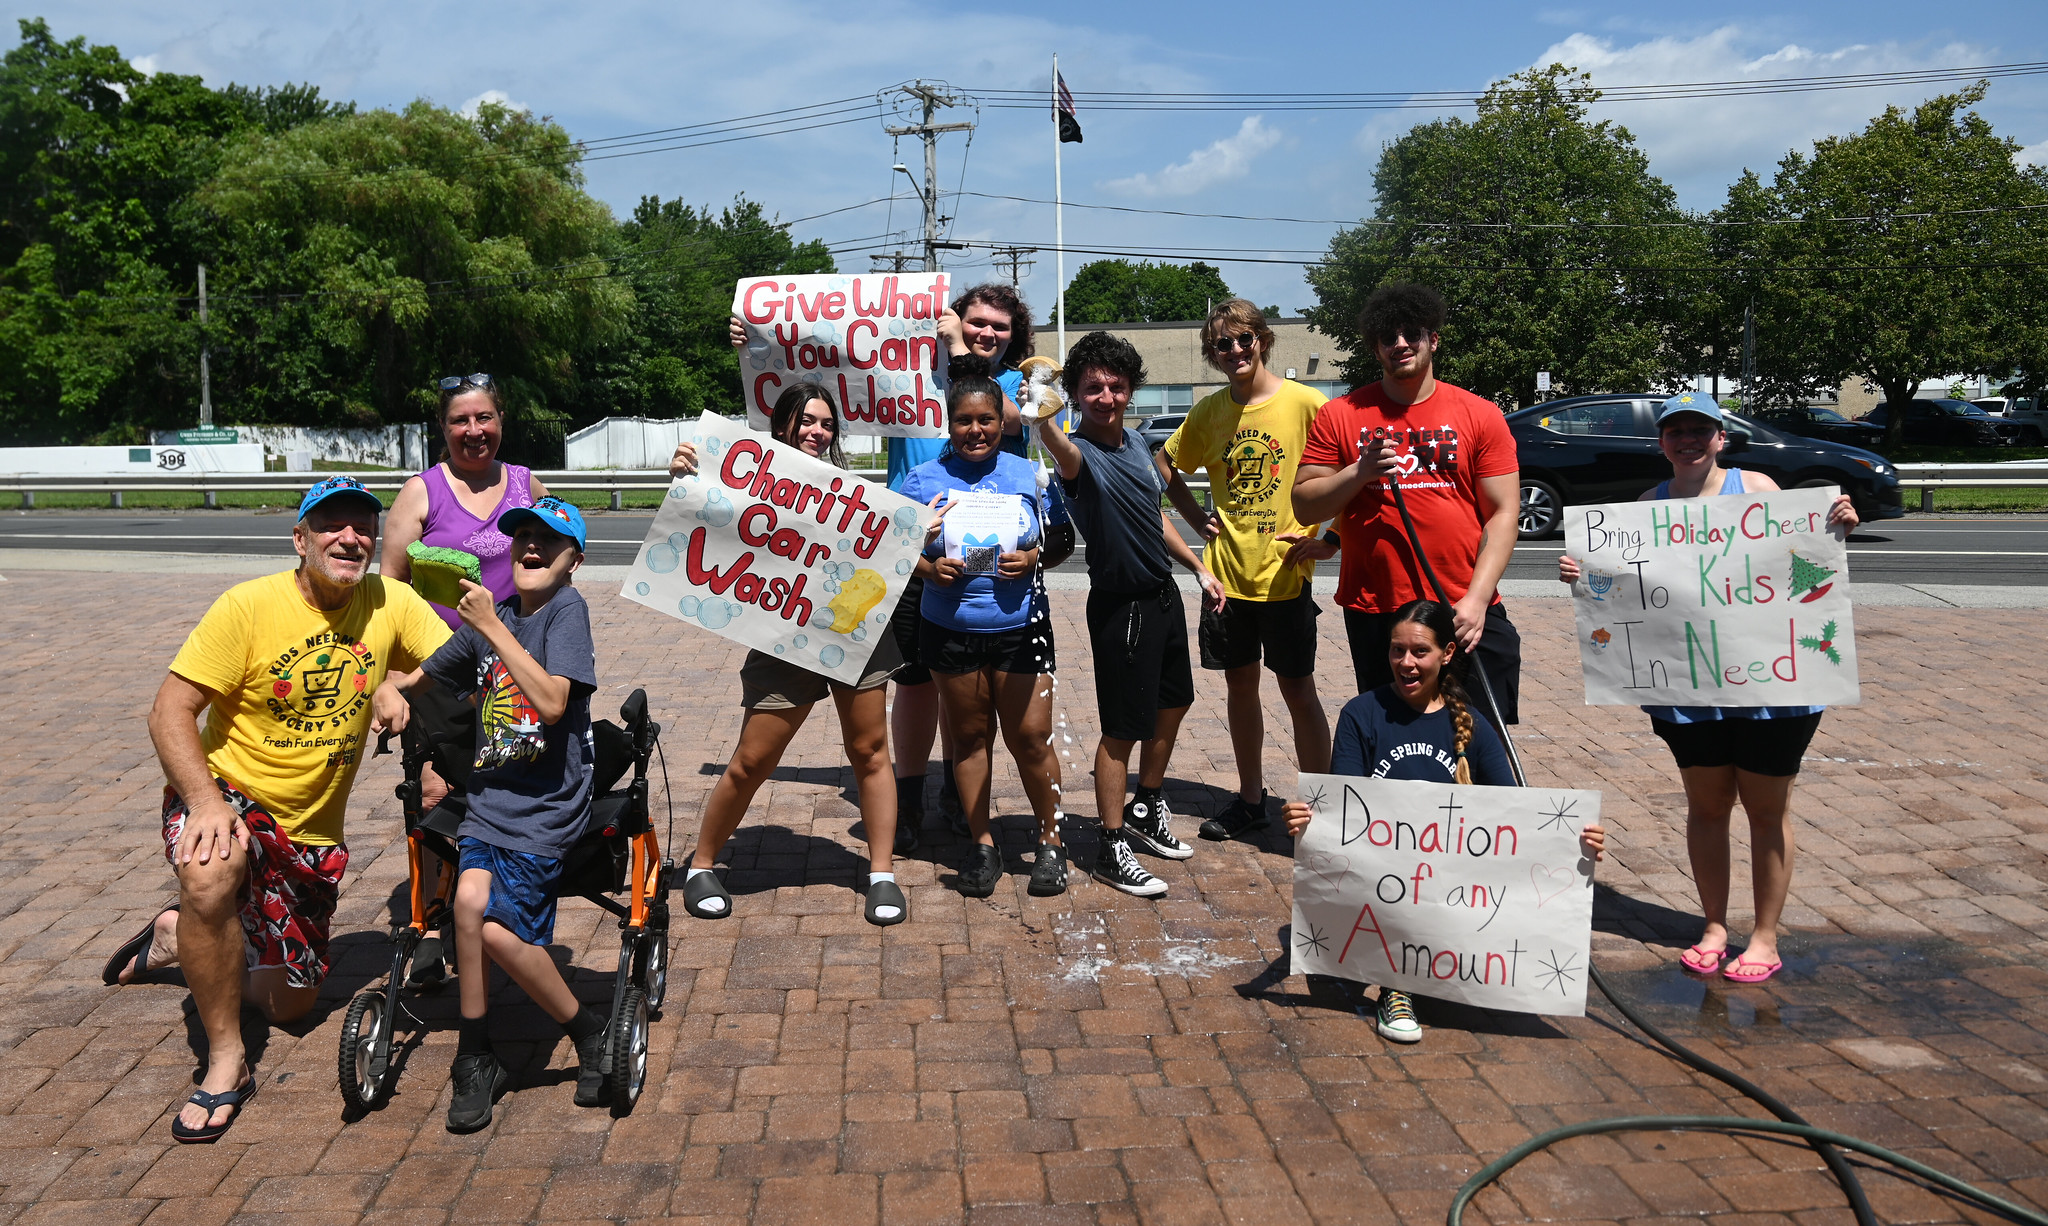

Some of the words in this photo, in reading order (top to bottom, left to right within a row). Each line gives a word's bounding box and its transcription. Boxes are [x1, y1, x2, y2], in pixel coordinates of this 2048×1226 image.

[743, 280, 847, 324] Give
[853, 275, 950, 320] What
[775, 322, 839, 370] You
[846, 319, 938, 371] Can
[837, 373, 942, 428] Wash
[159, 454, 185, 466] 399
[1236, 429, 1259, 441] NEED
[1360, 430, 1404, 445] KDS
[1409, 429, 1458, 444] NEED
[720, 439, 889, 559] Charity
[738, 503, 831, 568] Car
[1585, 510, 1645, 561] Bring
[1652, 504, 1735, 556] Holiday
[1741, 502, 1821, 539] Cheer
[686, 527, 813, 627] Wash
[1627, 560, 1669, 610] To
[1699, 554, 1775, 607] Kids
[306, 632, 340, 648] NEED
[1613, 620, 1669, 689] In
[1685, 618, 1797, 689] Need
[263, 736, 292, 748] Fresh
[295, 737, 313, 748] Fun
[315, 736, 344, 749] Every
[1371, 759, 1392, 779] OLD
[1390, 742, 1434, 761] SPRING
[1342, 784, 1518, 857] Donation
[1377, 862, 1433, 904] of
[1446, 884, 1507, 932] any
[1338, 903, 1528, 987] Amount
